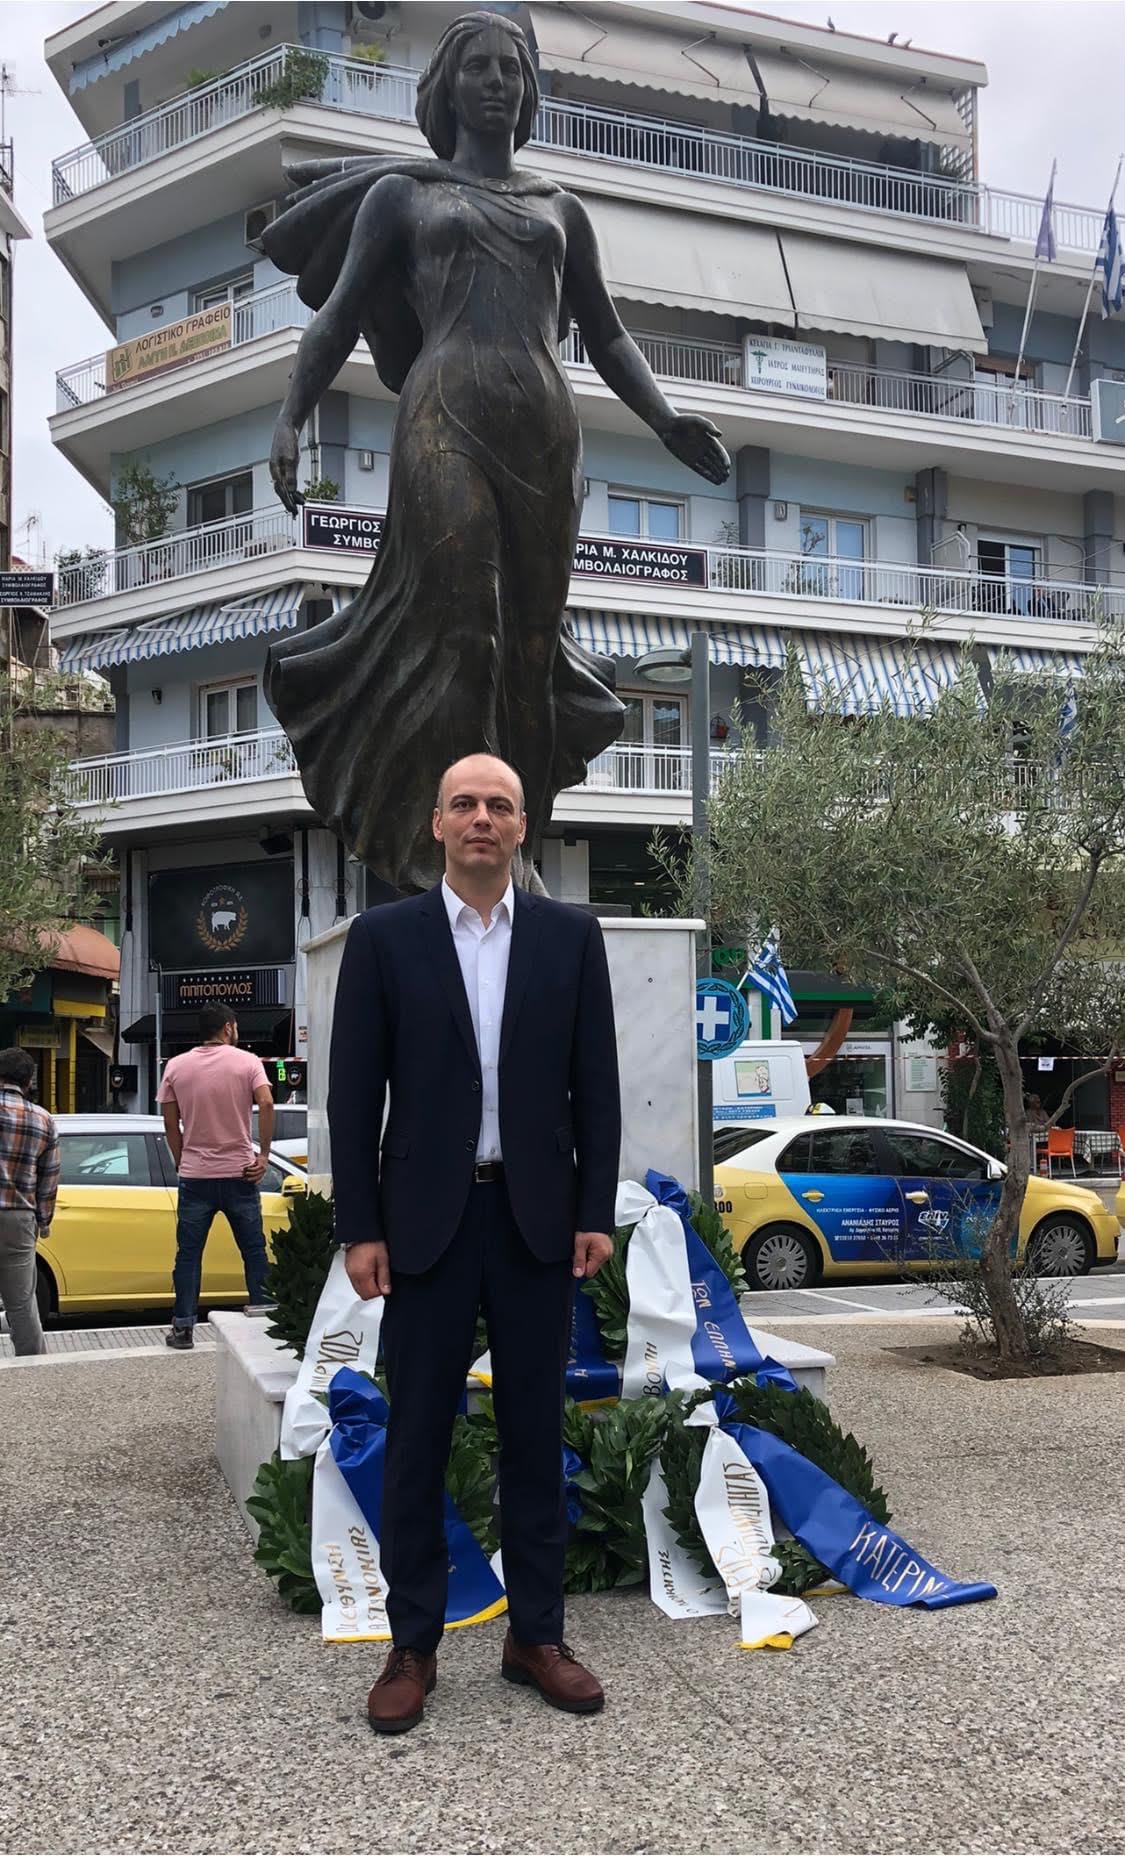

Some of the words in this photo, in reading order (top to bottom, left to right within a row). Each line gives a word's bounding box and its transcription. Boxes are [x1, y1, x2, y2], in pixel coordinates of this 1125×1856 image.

[136, 325, 184, 353] ΛΟΓΙΣΤΙΚΟ
[186, 306, 231, 333] ΓΡΑΦΕΙΟ
[311, 514, 381, 534] ΓΕΩΡΓΙΟΣ
[333, 533, 381, 550] ΣΥΜΒΟ
[575, 543, 599, 557] ΡΙΑ
[602, 546, 617, 559] Μ.
[621, 548, 688, 566] ΧΑΛΚΙΔΟΥ
[573, 558, 688, 581] ΜΒΟΛΑΙΟΓΡΑΦΟΣ
